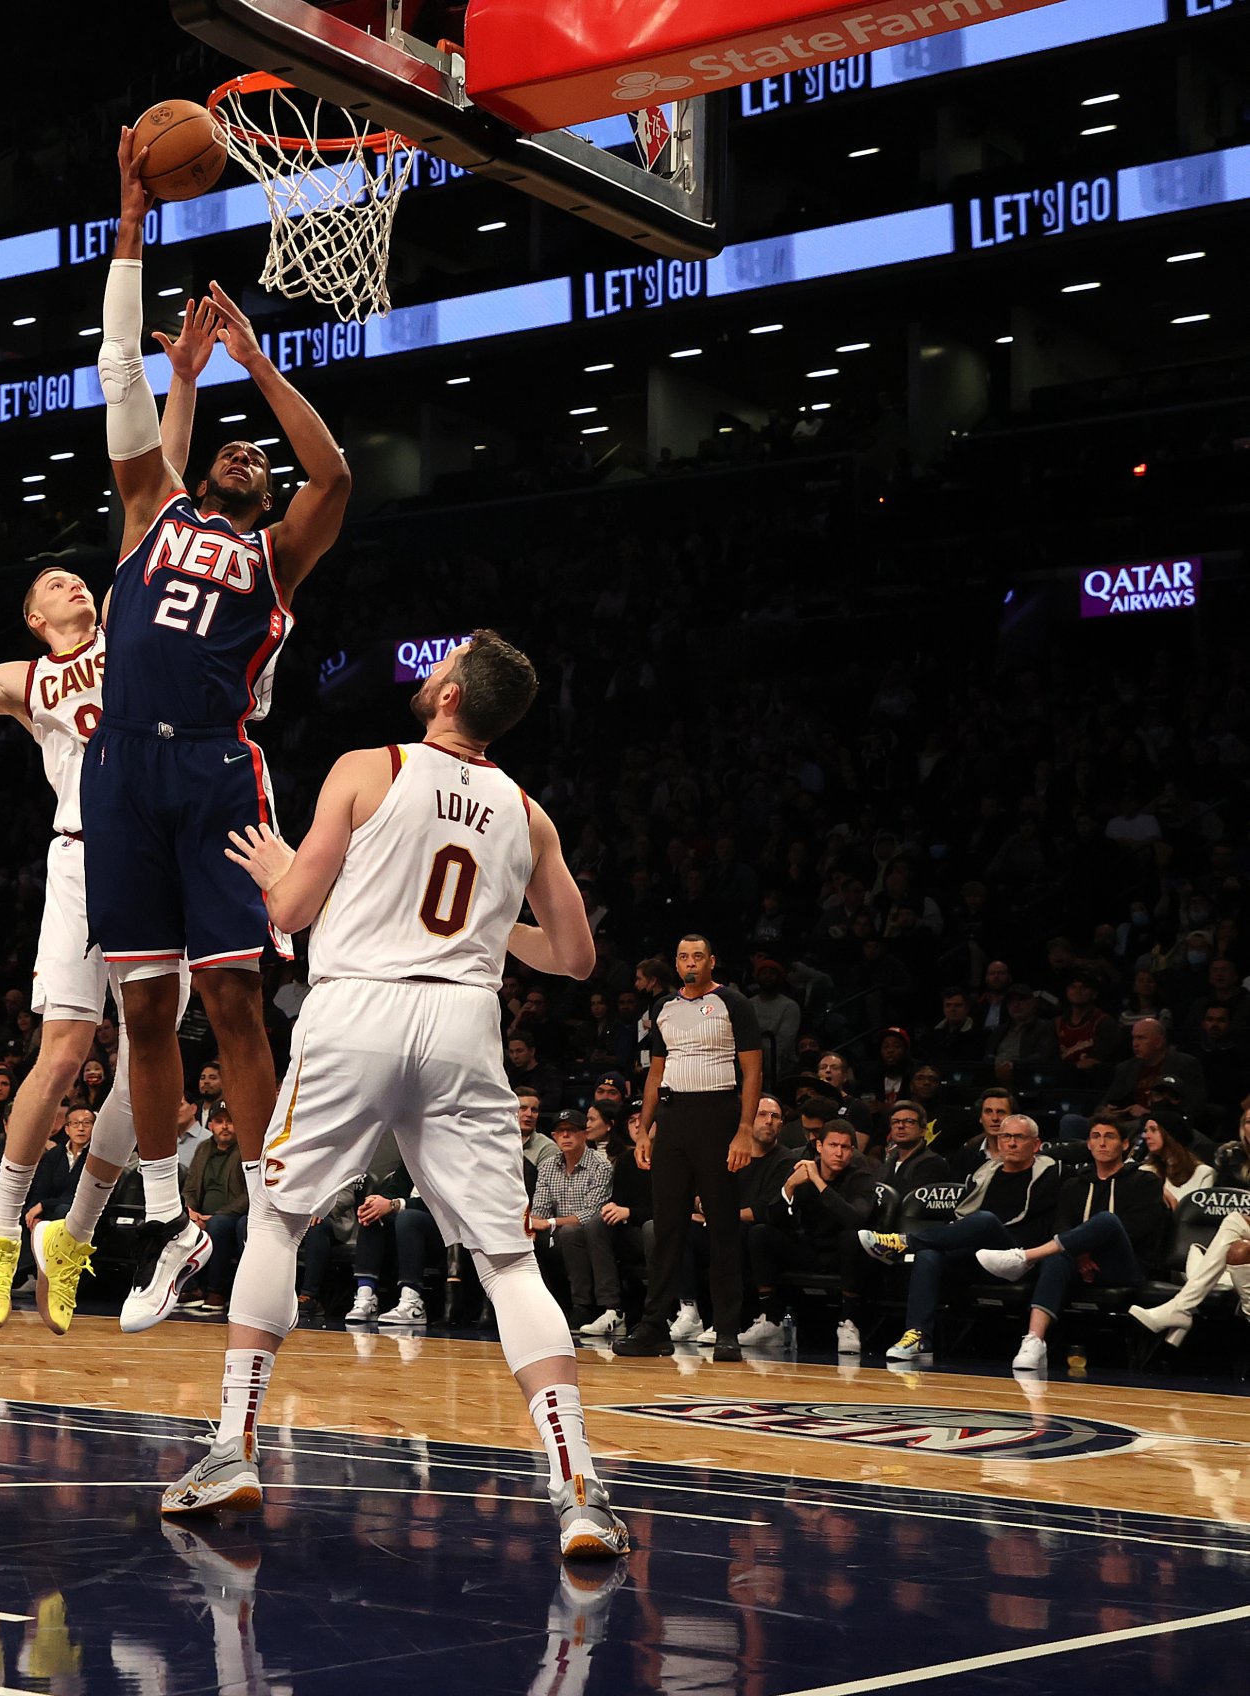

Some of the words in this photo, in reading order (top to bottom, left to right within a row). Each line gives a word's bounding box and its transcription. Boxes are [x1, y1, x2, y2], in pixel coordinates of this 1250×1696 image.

[830, 54, 865, 92] GO
[1070, 177, 1111, 226] GO
[69, 217, 121, 264] LET'
[668, 259, 701, 300] GO
[332, 320, 360, 360] GO
[46, 374, 70, 411] GO
[144, 519, 263, 594] NETS
[1084, 561, 1194, 601] QATAR
[1109, 588, 1196, 613] AIRWAYS
[153, 577, 221, 638] 21
[436, 789, 494, 835] LOVE
[418, 842, 479, 940] 0
[925, 1200, 958, 1210] AIRWA
[1191, 1191, 1250, 1208] QATAR
